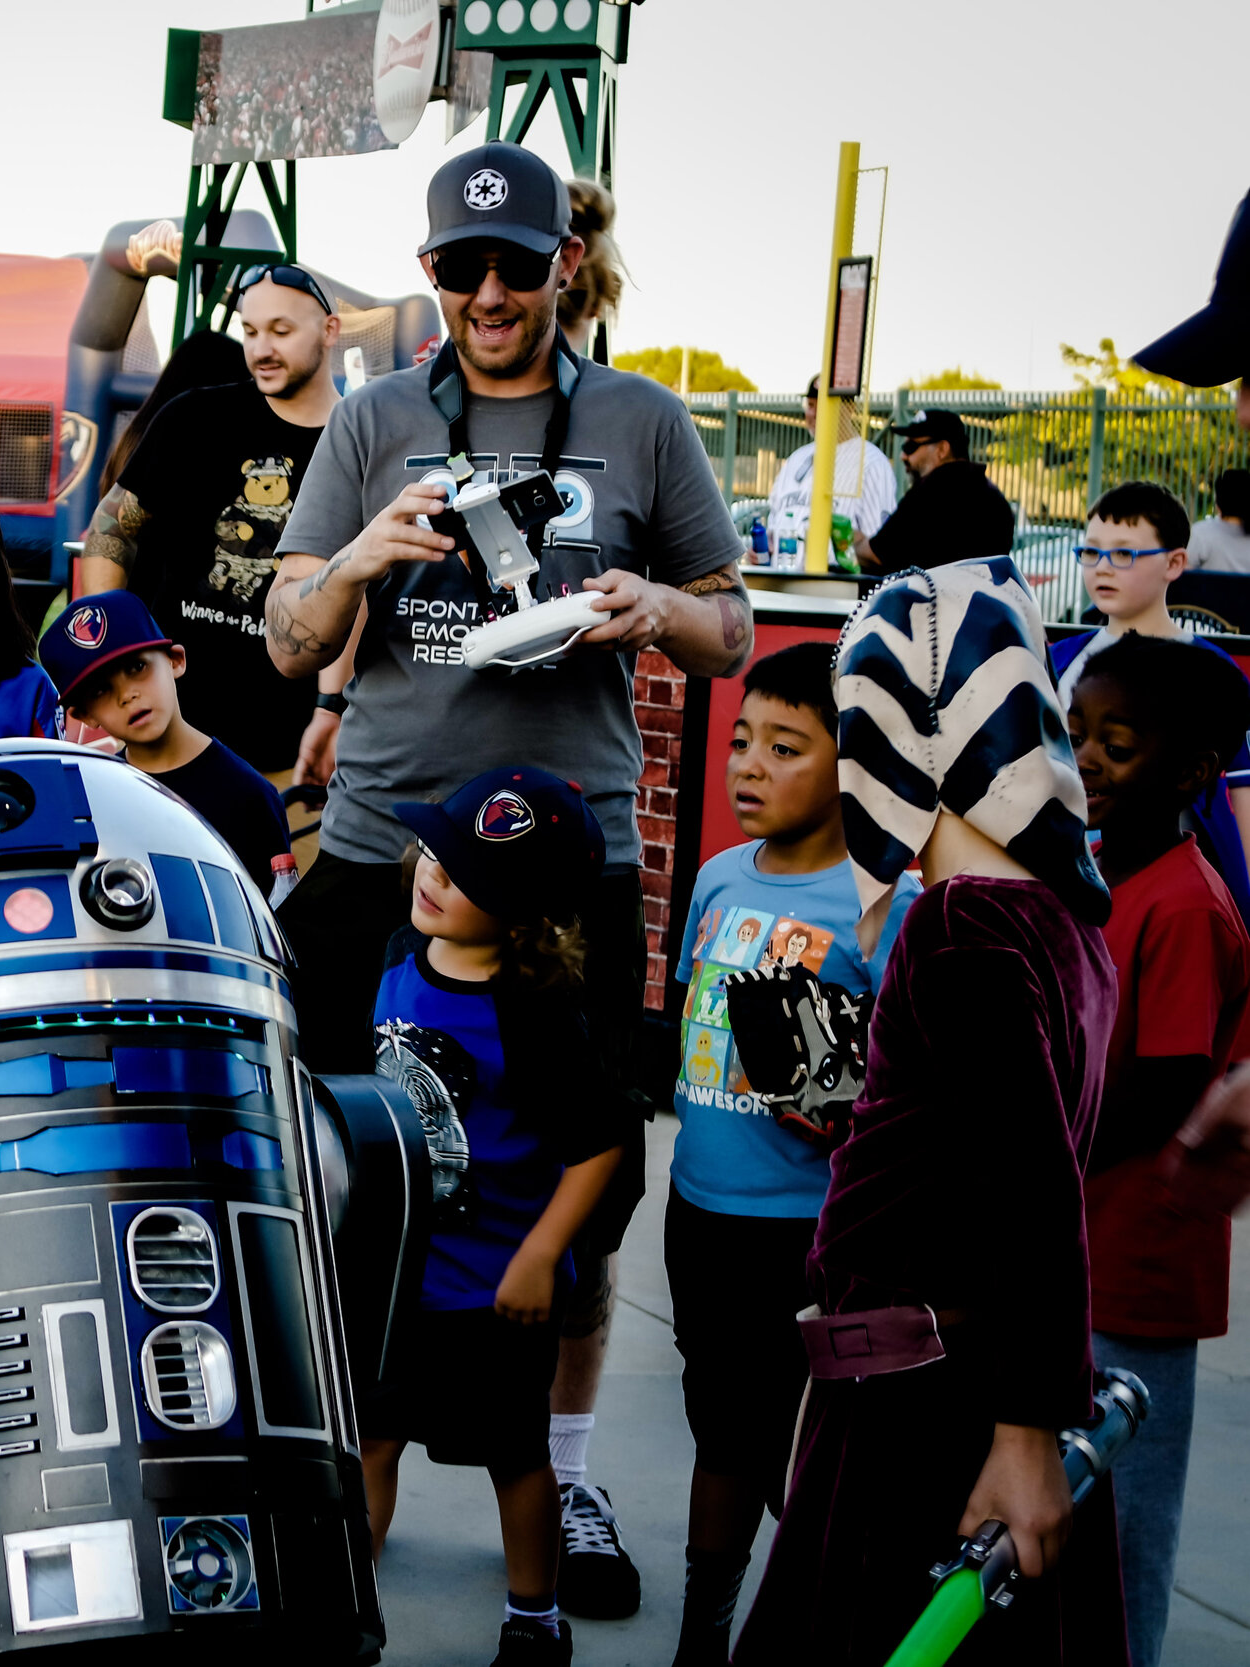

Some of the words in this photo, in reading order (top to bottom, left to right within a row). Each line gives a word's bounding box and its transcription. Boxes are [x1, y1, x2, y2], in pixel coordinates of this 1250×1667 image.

[181, 600, 225, 624] Winnie
[413, 643, 467, 665] RES
[688, 1084, 774, 1117] AWESOM
